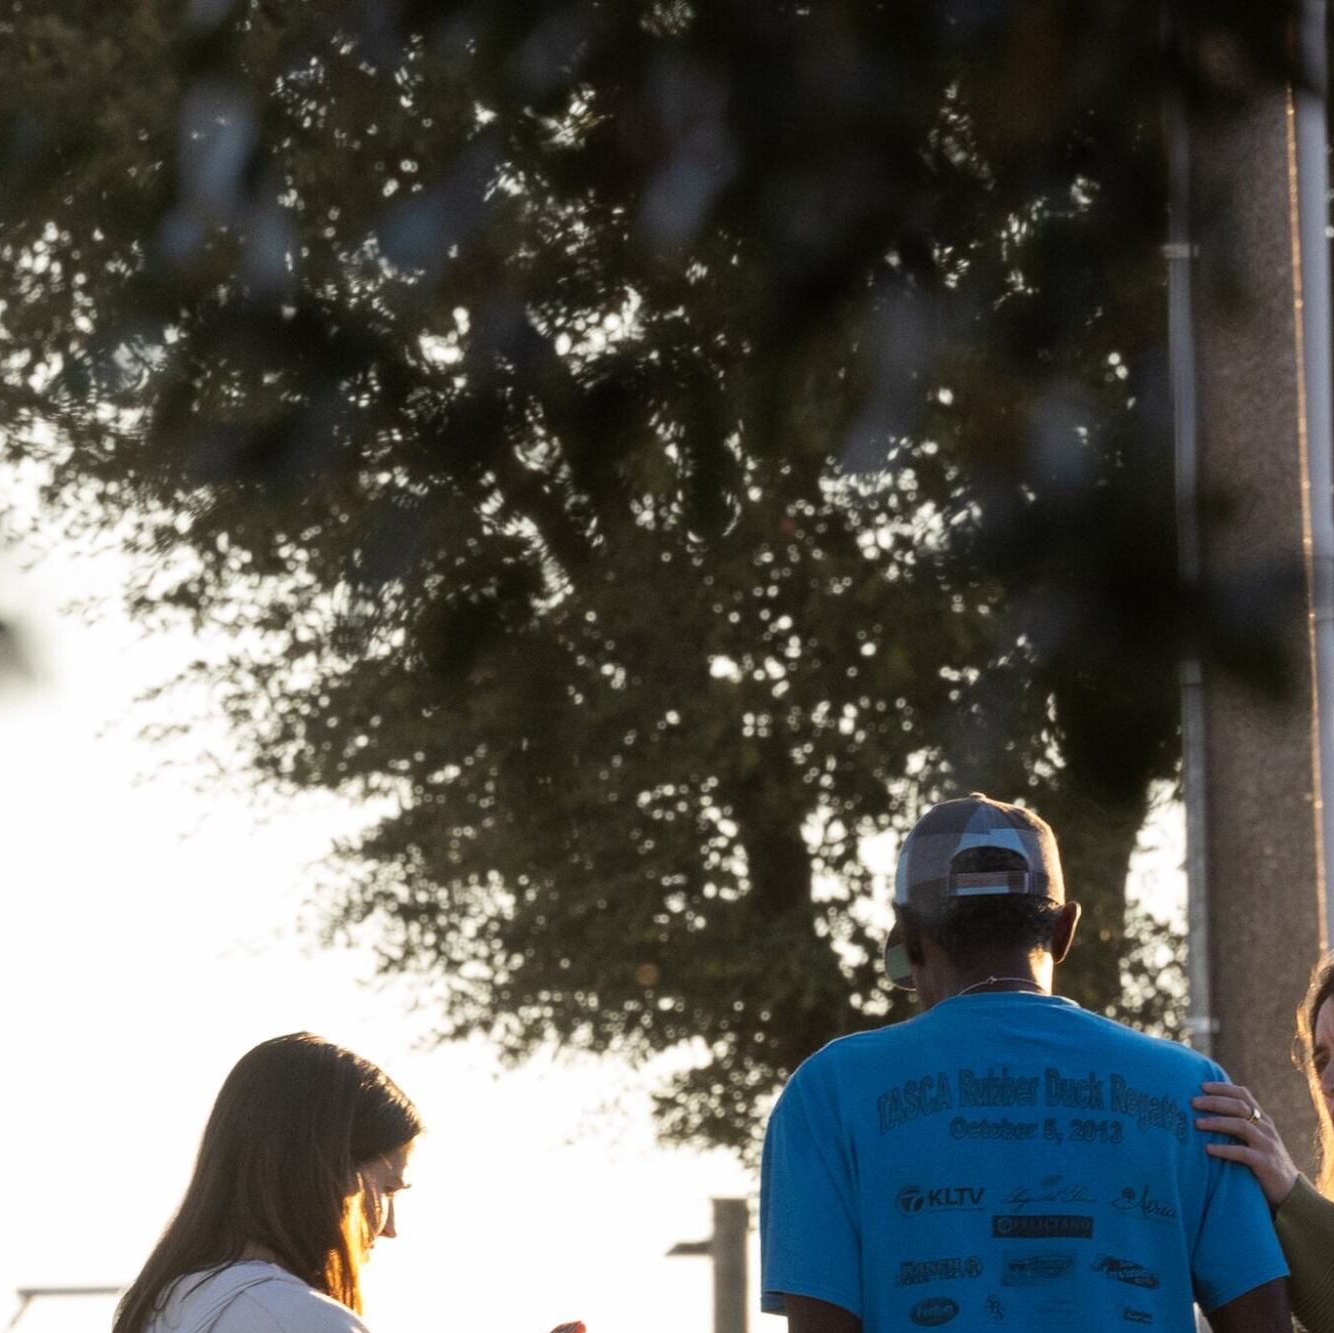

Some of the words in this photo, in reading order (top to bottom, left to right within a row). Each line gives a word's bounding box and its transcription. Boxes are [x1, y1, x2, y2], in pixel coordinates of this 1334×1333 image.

[958, 1064, 1041, 1108] Rubber
[1044, 1067, 1104, 1110] Duck
[1110, 1072, 1188, 1144] Regatta
[950, 1116, 1037, 1141] October
[1043, 1117, 1063, 1145] 5,
[1068, 1118, 1123, 1144] 2013
[928, 1186, 985, 1208] KLTV
